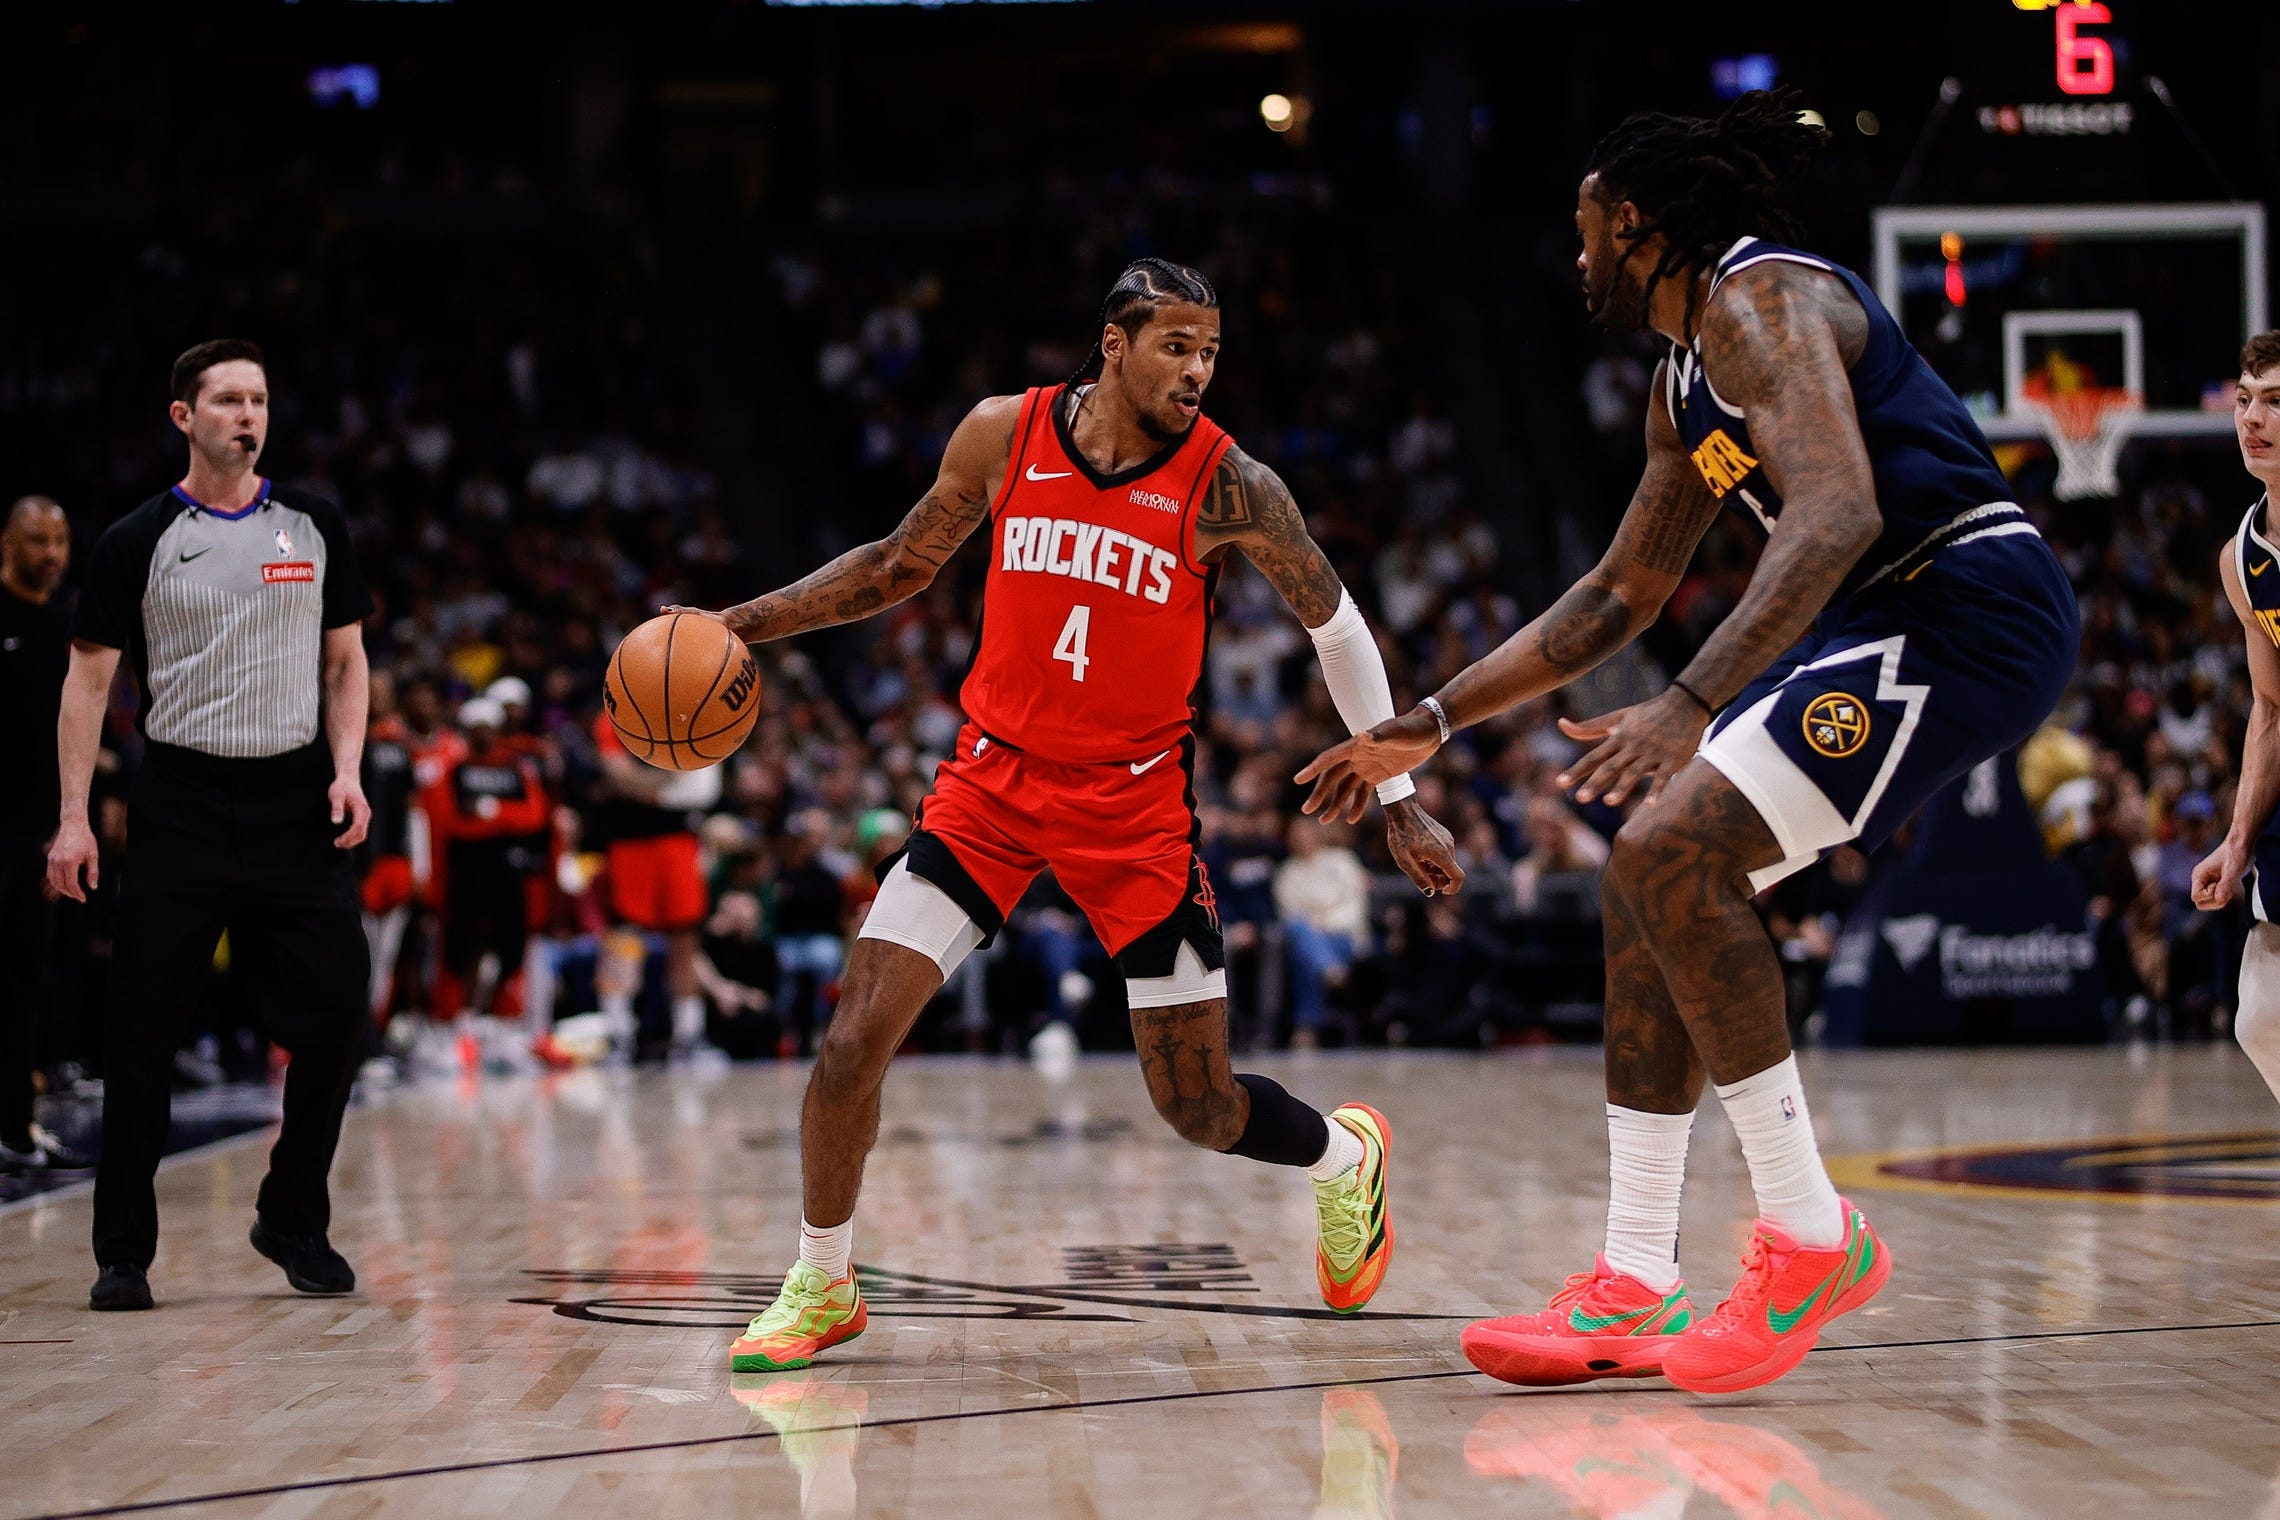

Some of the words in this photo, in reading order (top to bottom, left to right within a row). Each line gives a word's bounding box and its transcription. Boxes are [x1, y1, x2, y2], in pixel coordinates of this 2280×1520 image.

[2055, 2, 2114, 95] 6
[1129, 496, 1179, 514] HERMANN
[1130, 489, 1179, 508] MEMORIAL
[263, 565, 313, 580] Emirates
[1001, 516, 1178, 605] ROCKETS
[1052, 604, 1091, 682] 4
